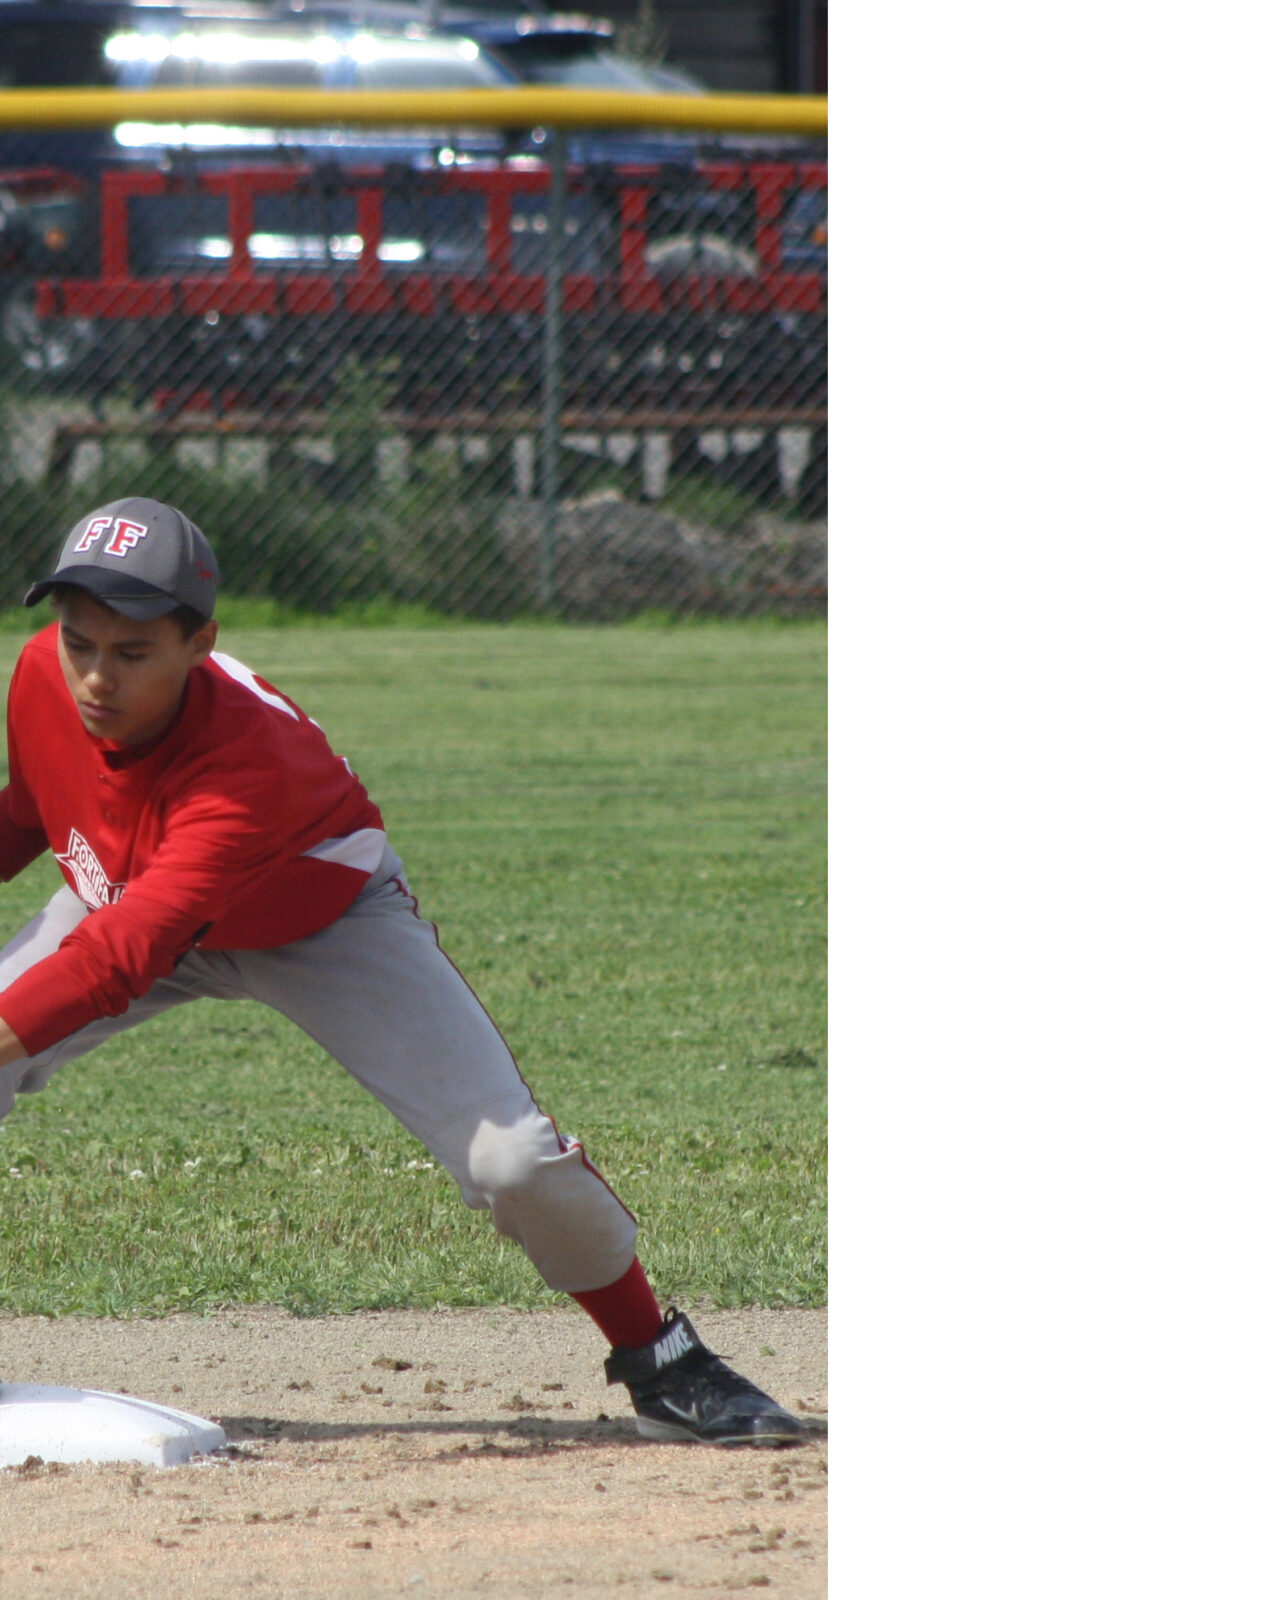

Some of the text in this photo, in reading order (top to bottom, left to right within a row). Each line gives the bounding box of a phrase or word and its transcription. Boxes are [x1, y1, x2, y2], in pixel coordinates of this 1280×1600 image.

[73, 516, 148, 558] FF
[70, 834, 99, 884] FORT
[654, 1322, 693, 1369] NIKE
